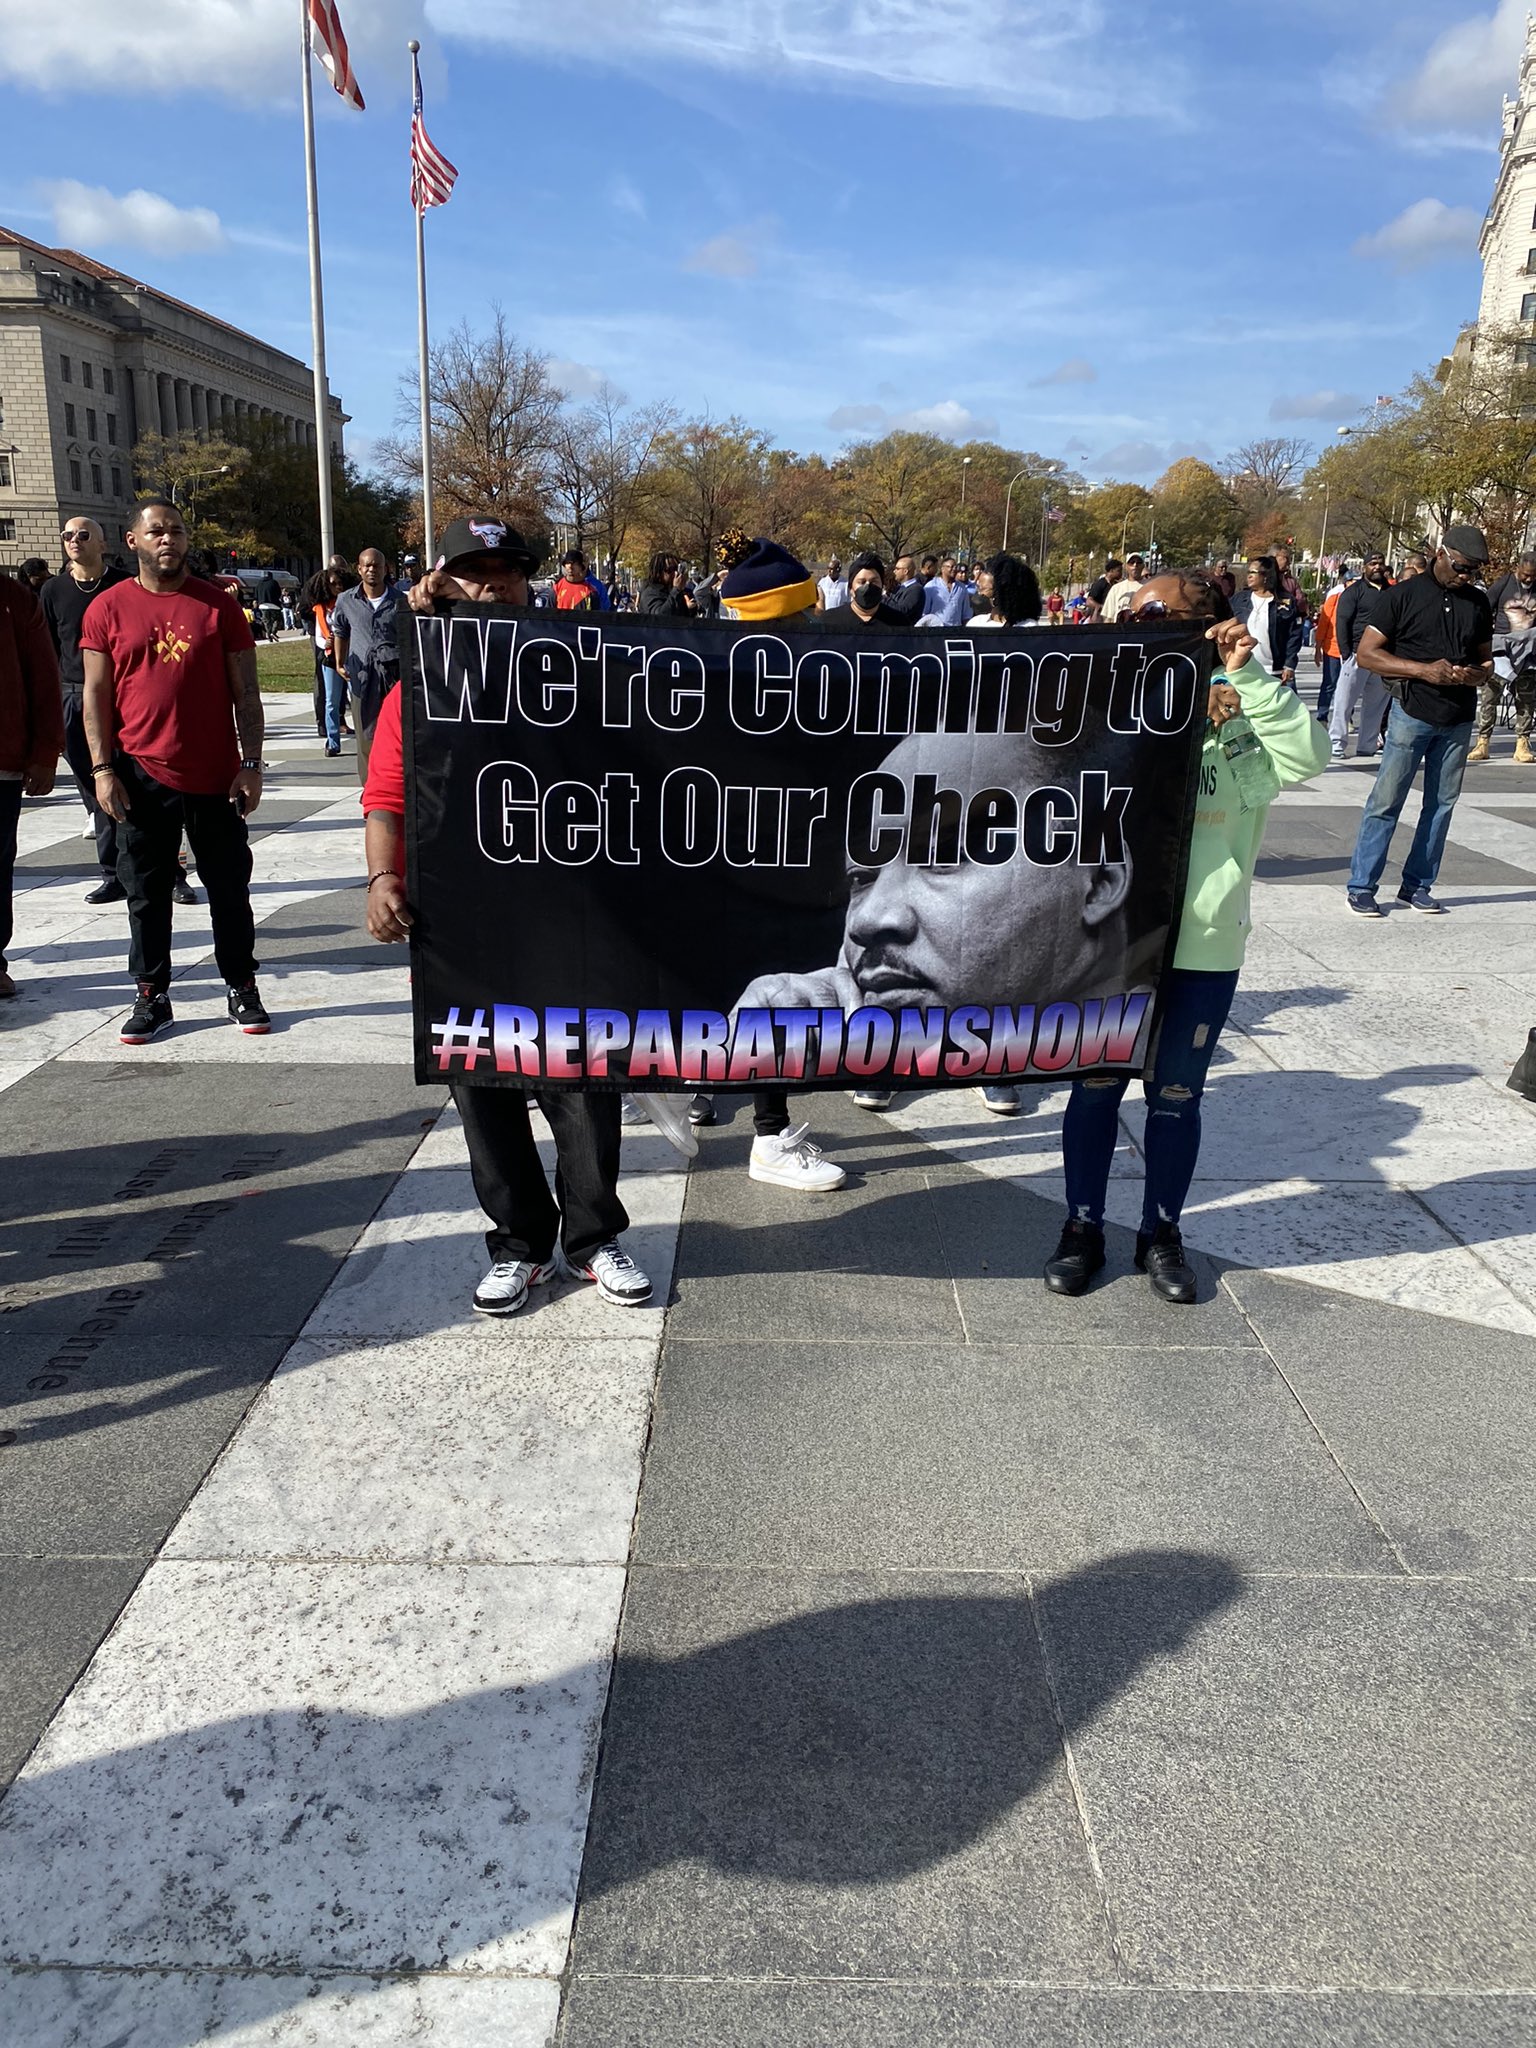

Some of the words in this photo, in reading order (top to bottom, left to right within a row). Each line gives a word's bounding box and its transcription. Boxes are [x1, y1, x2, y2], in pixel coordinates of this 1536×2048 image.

[415, 616, 706, 732] We're
[729, 634, 1093, 747] Coming
[1107, 643, 1197, 735] to
[476, 761, 640, 866] Get
[661, 766, 828, 867] Our
[845, 770, 1133, 869] Check
[431, 992, 1152, 1082] #REPARATIONSNOW
[26, 1288, 146, 1391] avenue
